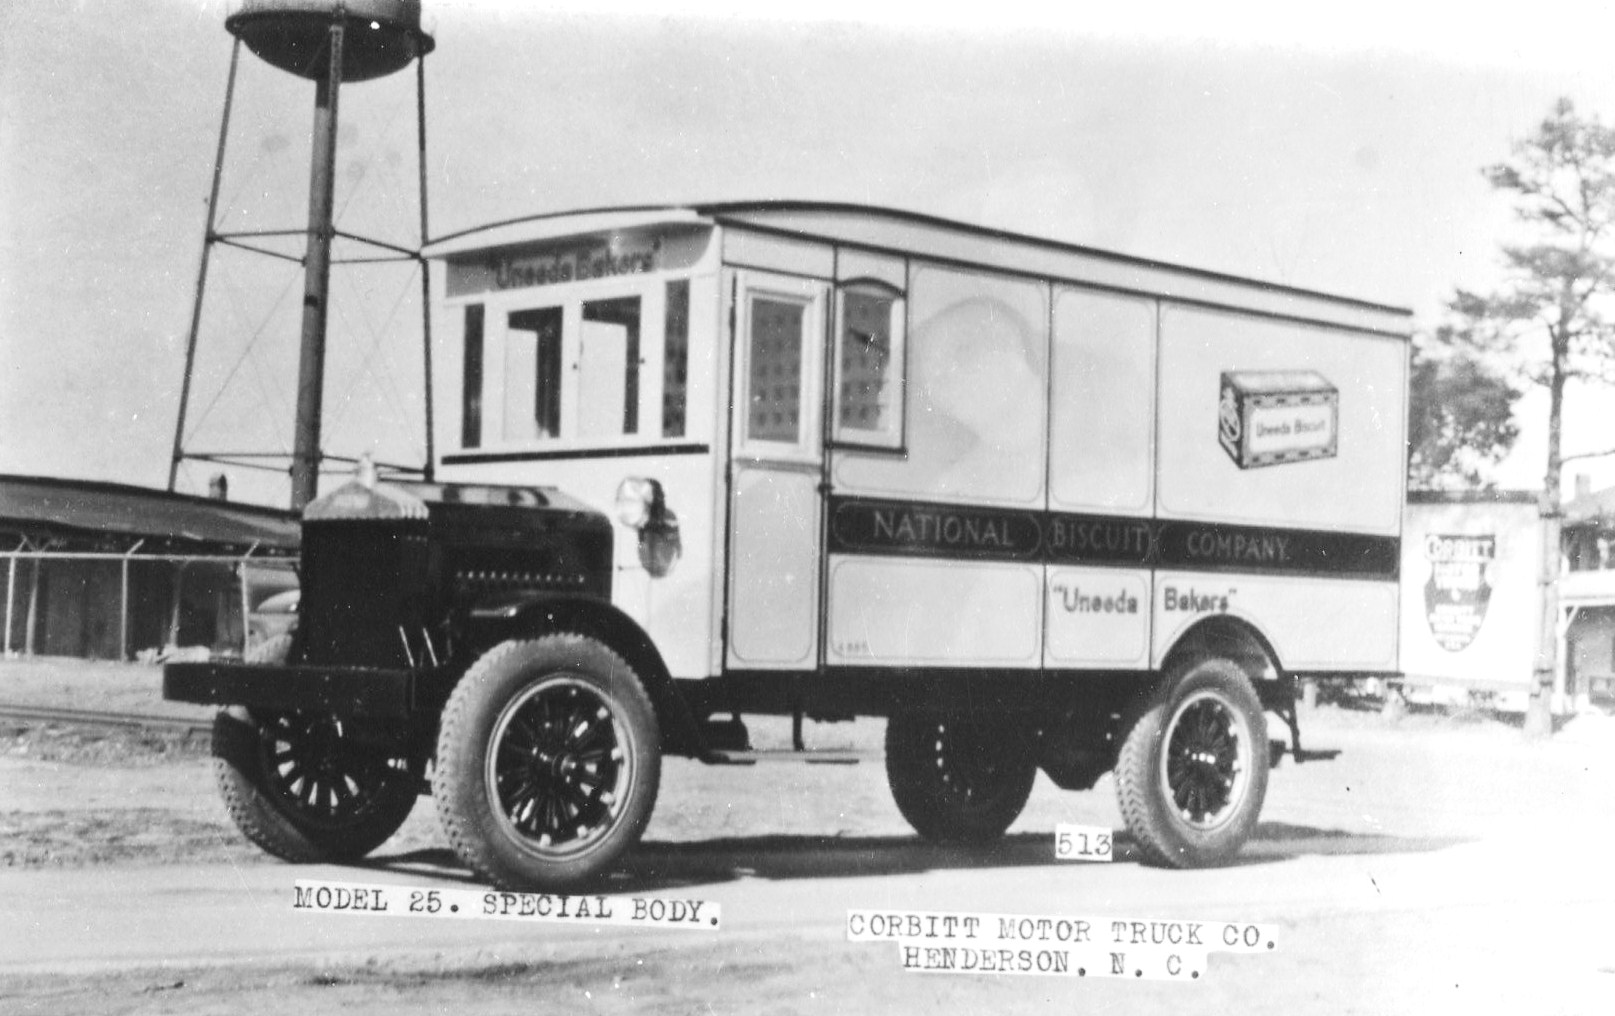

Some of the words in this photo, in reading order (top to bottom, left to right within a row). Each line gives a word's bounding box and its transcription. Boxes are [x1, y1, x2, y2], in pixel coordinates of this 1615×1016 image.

[873, 511, 1014, 546] NATIONAL
[1052, 520, 1147, 552] BISCUIT
[1187, 531, 1290, 560] COMPANY
